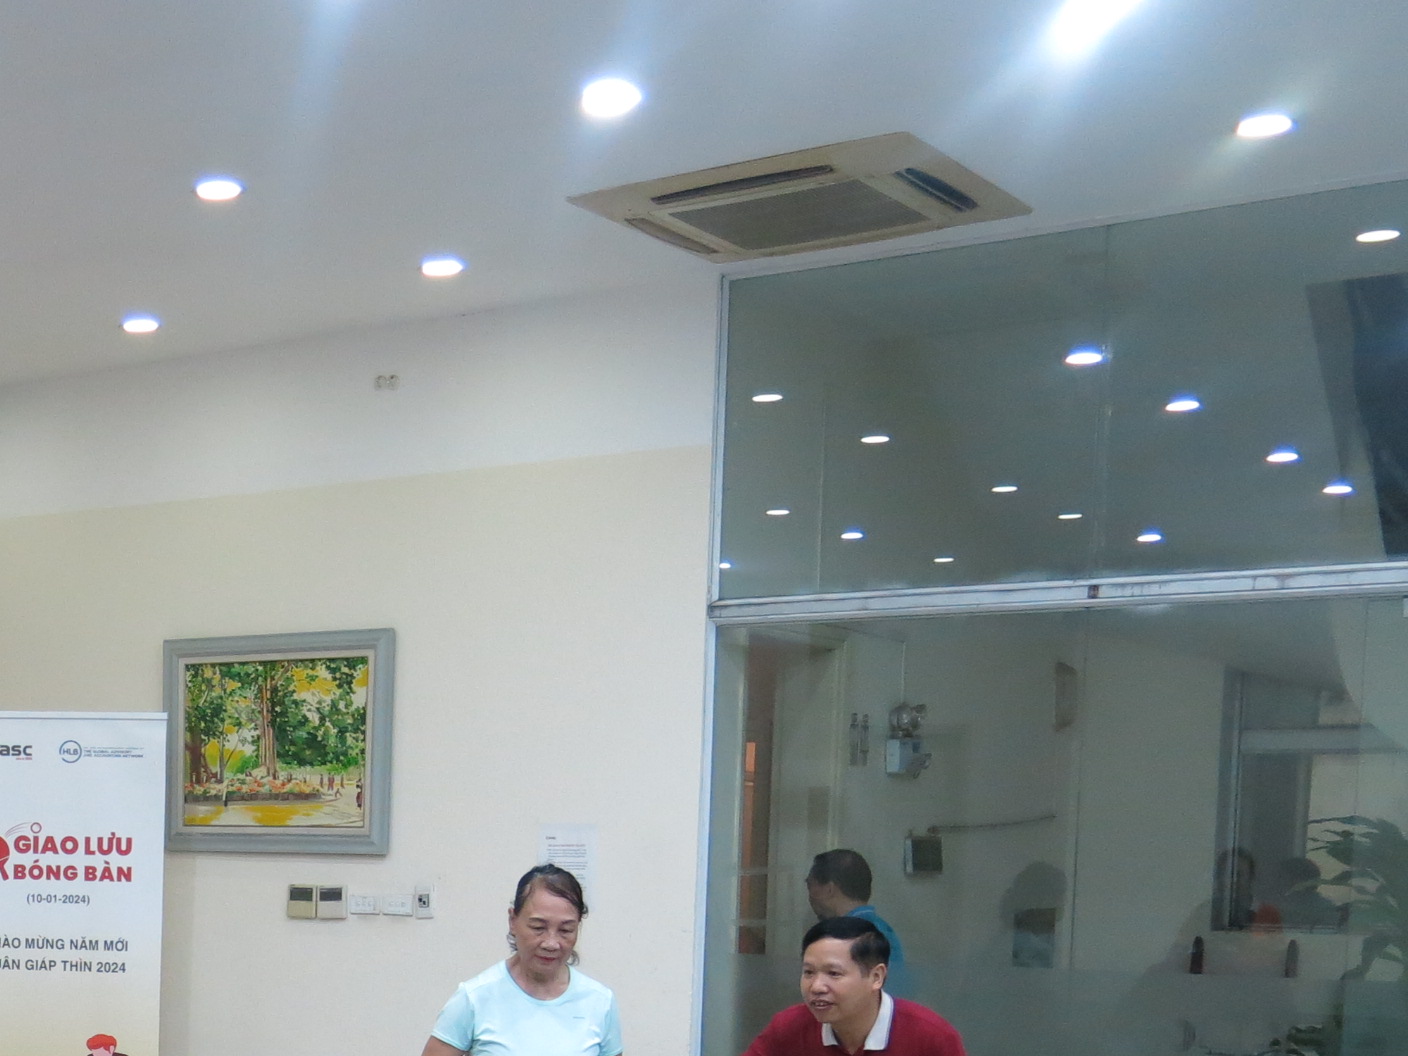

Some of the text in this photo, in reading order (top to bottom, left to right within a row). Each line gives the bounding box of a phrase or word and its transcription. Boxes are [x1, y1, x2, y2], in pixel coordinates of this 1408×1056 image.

[62, 748, 79, 756] HLB
[13, 832, 133, 856] GIAO LƯU
[13, 859, 132, 882] BÓNG BÀN
[26, 893, 90, 906] (10-01-2024)
[25, 935, 65, 950] MỪNG
[70, 936, 99, 951] NĂM
[103, 937, 128, 952] MỚI
[25, 956, 57, 971] GIÁP
[61, 957, 93, 972] THÌN
[96, 962, 126, 973] 2024
